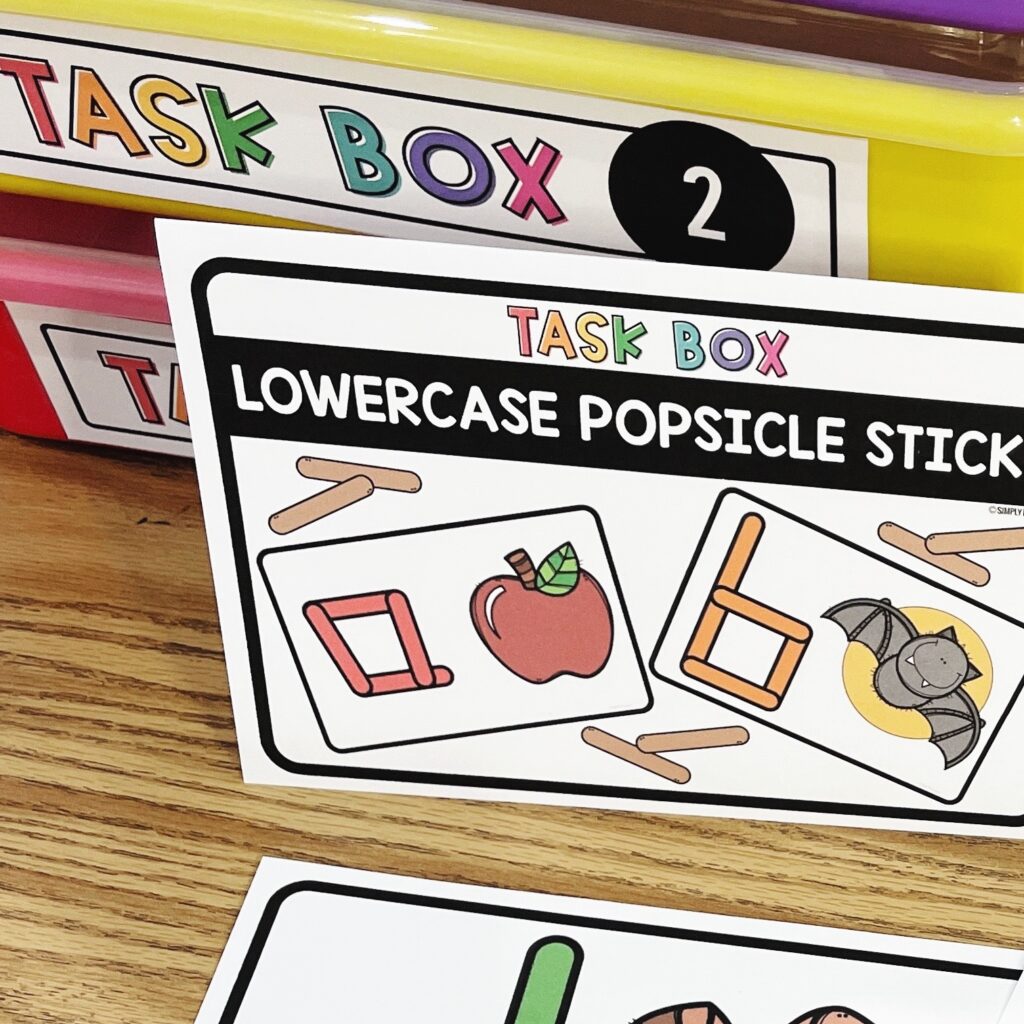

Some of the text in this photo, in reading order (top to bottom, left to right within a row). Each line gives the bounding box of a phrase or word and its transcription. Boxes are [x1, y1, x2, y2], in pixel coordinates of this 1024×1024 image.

[0, 53, 570, 227] TASK BOX
[682, 166, 728, 242] 2
[507, 305, 789, 377] TASK BOX
[230, 363, 558, 439] LOWERCASE
[580, 394, 847, 465] POPSICLE
